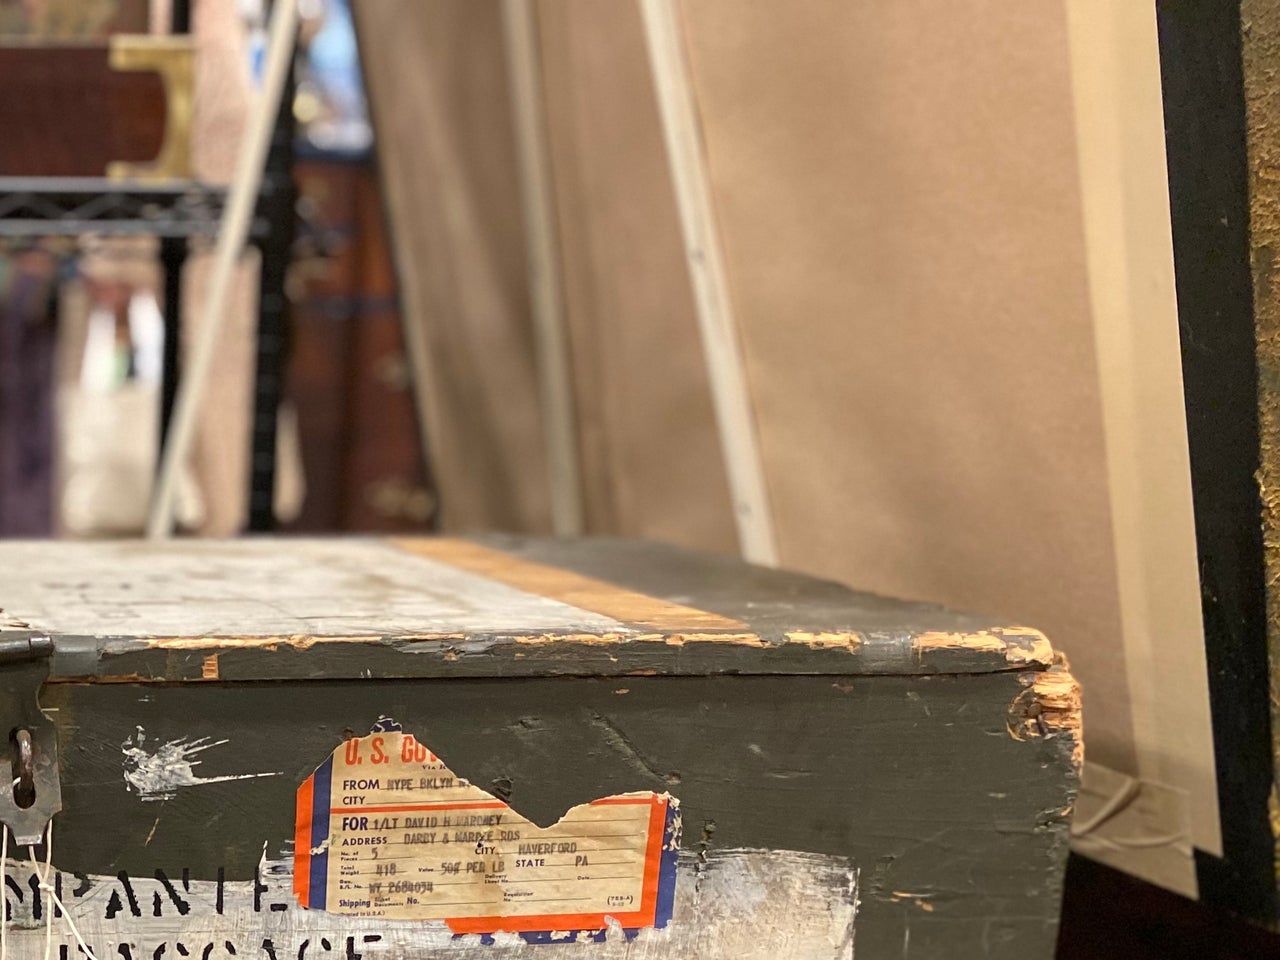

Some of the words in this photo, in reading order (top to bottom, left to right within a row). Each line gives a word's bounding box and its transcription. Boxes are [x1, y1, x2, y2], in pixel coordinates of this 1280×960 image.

[343, 779, 380, 791] FROM
[342, 796, 366, 805] CITY
[342, 817, 369, 831] FOR
[405, 816, 438, 829] DAVID
[342, 836, 388, 847] ADDRESS
[475, 846, 496, 855] CITY
[518, 842, 577, 856] HAVERFORD
[515, 859, 545, 867] STATE
[575, 855, 589, 867] PA
[339, 899, 371, 909] Shipping
[407, 897, 420, 905] No.
